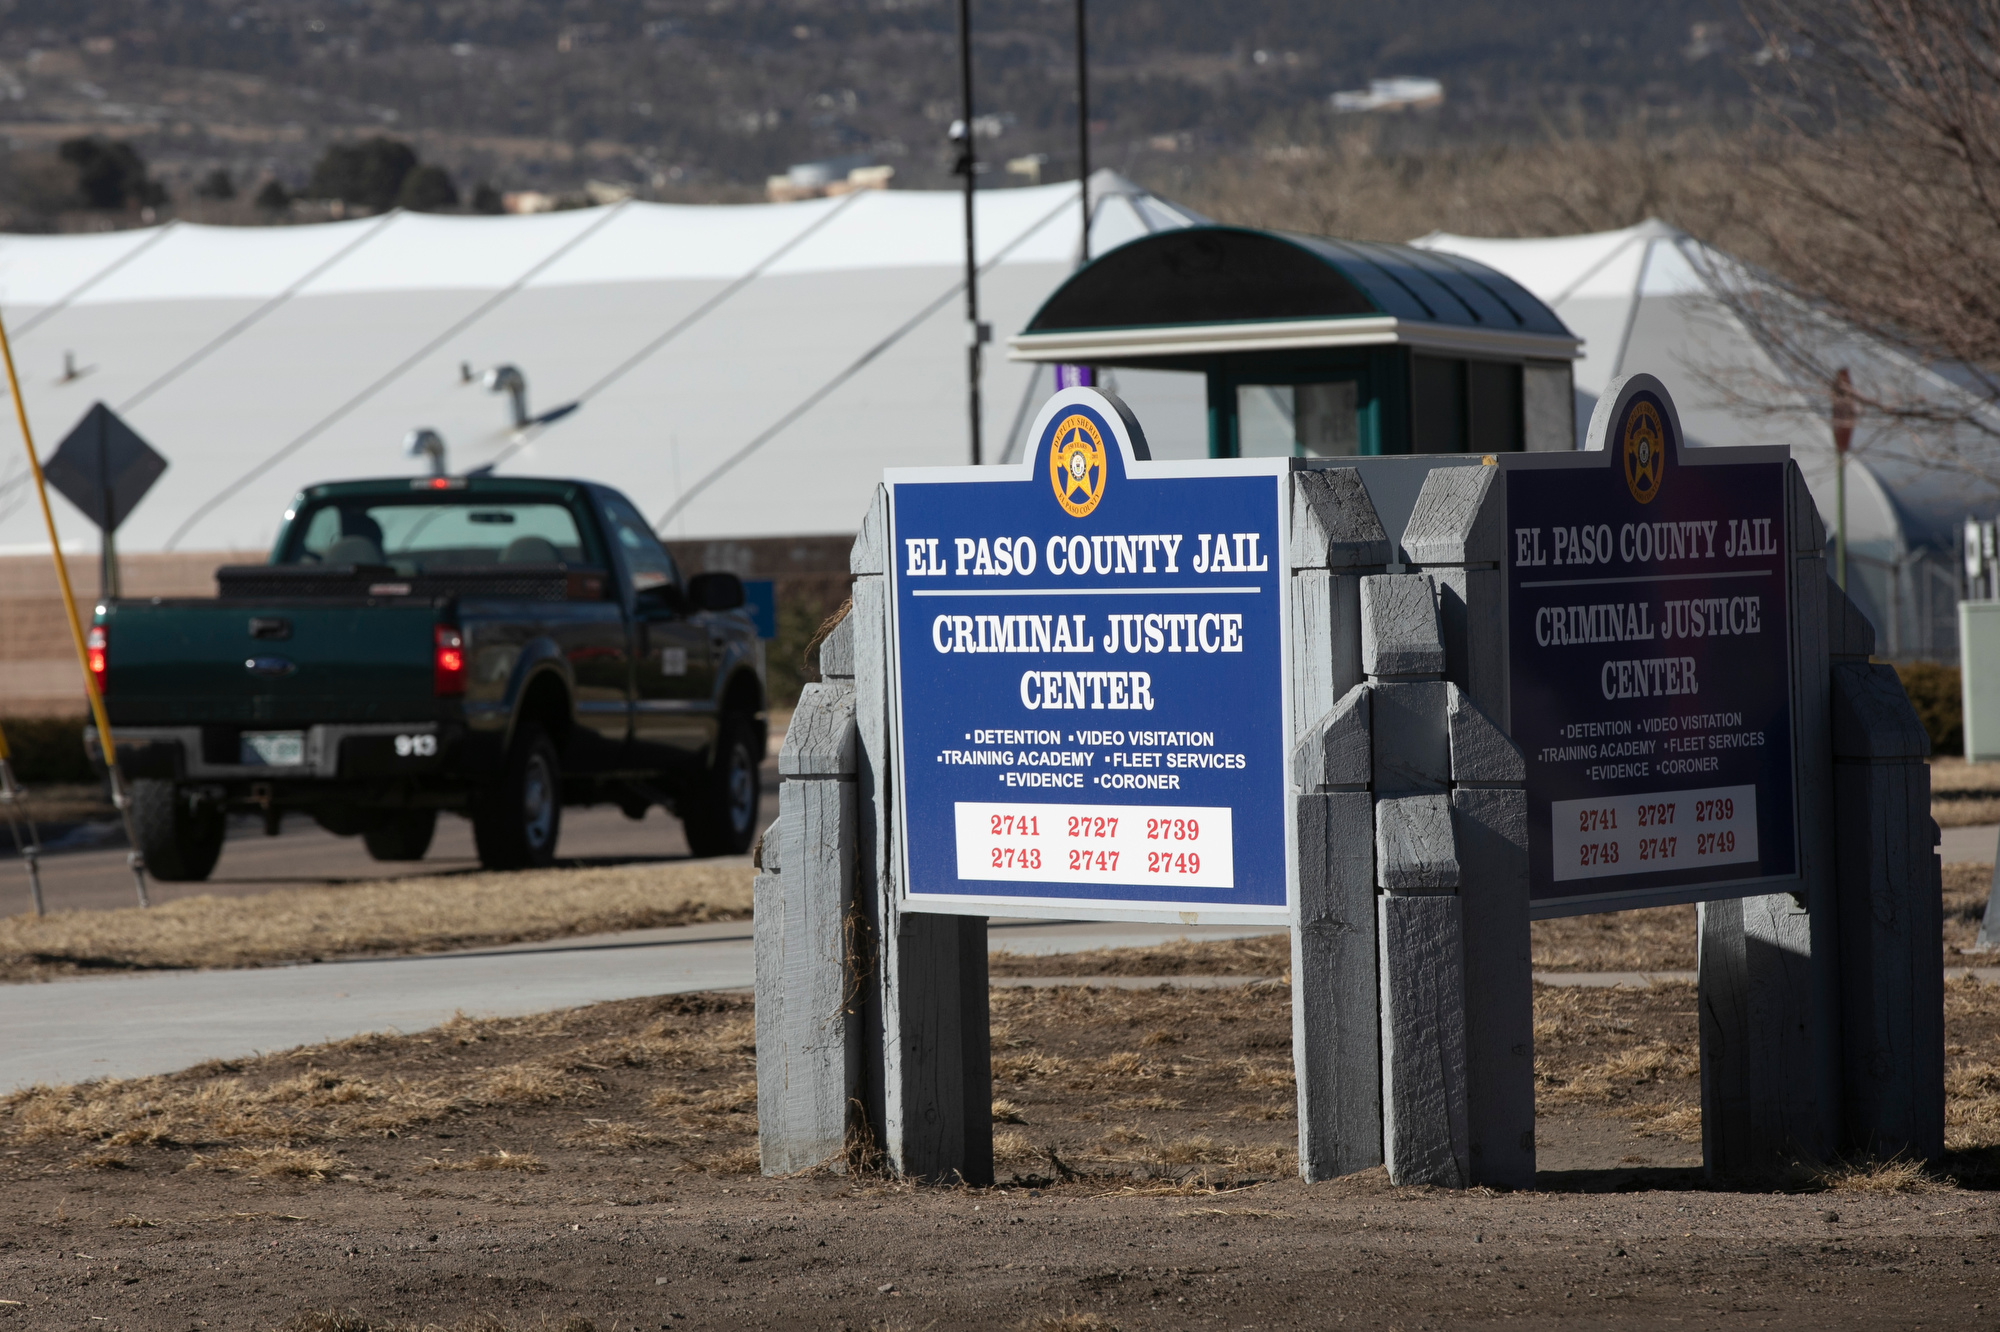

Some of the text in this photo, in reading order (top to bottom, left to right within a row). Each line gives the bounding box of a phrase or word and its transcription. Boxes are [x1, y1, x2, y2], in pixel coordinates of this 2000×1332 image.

[1054, 417, 1102, 448] DEPUTY SHERIFF
[1058, 493, 1100, 514] EL PASO COUNTY
[906, 533, 1267, 575] EL PASO COUNTY JAIL
[1516, 518, 1776, 566] EL PASO COUNTY JAIL
[933, 613, 1242, 653] CRIMINAL JUSTICE
[1536, 597, 1760, 646] CRIMINAL JUSTICE
[1021, 671, 1154, 710] CENTER
[1602, 657, 1698, 700] CENTER
[975, 730, 1213, 746] DETENTION VIDEO VISITATION
[1567, 712, 1742, 738] DETENTION VIDEO VISITATION
[942, 751, 1245, 768] TRAINING ACADEMY FLEET SERVICES
[1542, 732, 1764, 762] TRAINING ACADEMY FLEET SERVICES
[1007, 773, 1180, 789] EVIDENCE CORONER
[1592, 757, 1718, 780] EVIDENCE CORONER
[991, 815, 1199, 840] 2741 2727 2739
[1580, 798, 1733, 832] 2741 2727 2739
[992, 848, 1200, 874] 2743 2747 2749
[1581, 831, 1735, 866] 2743 2747 2749
